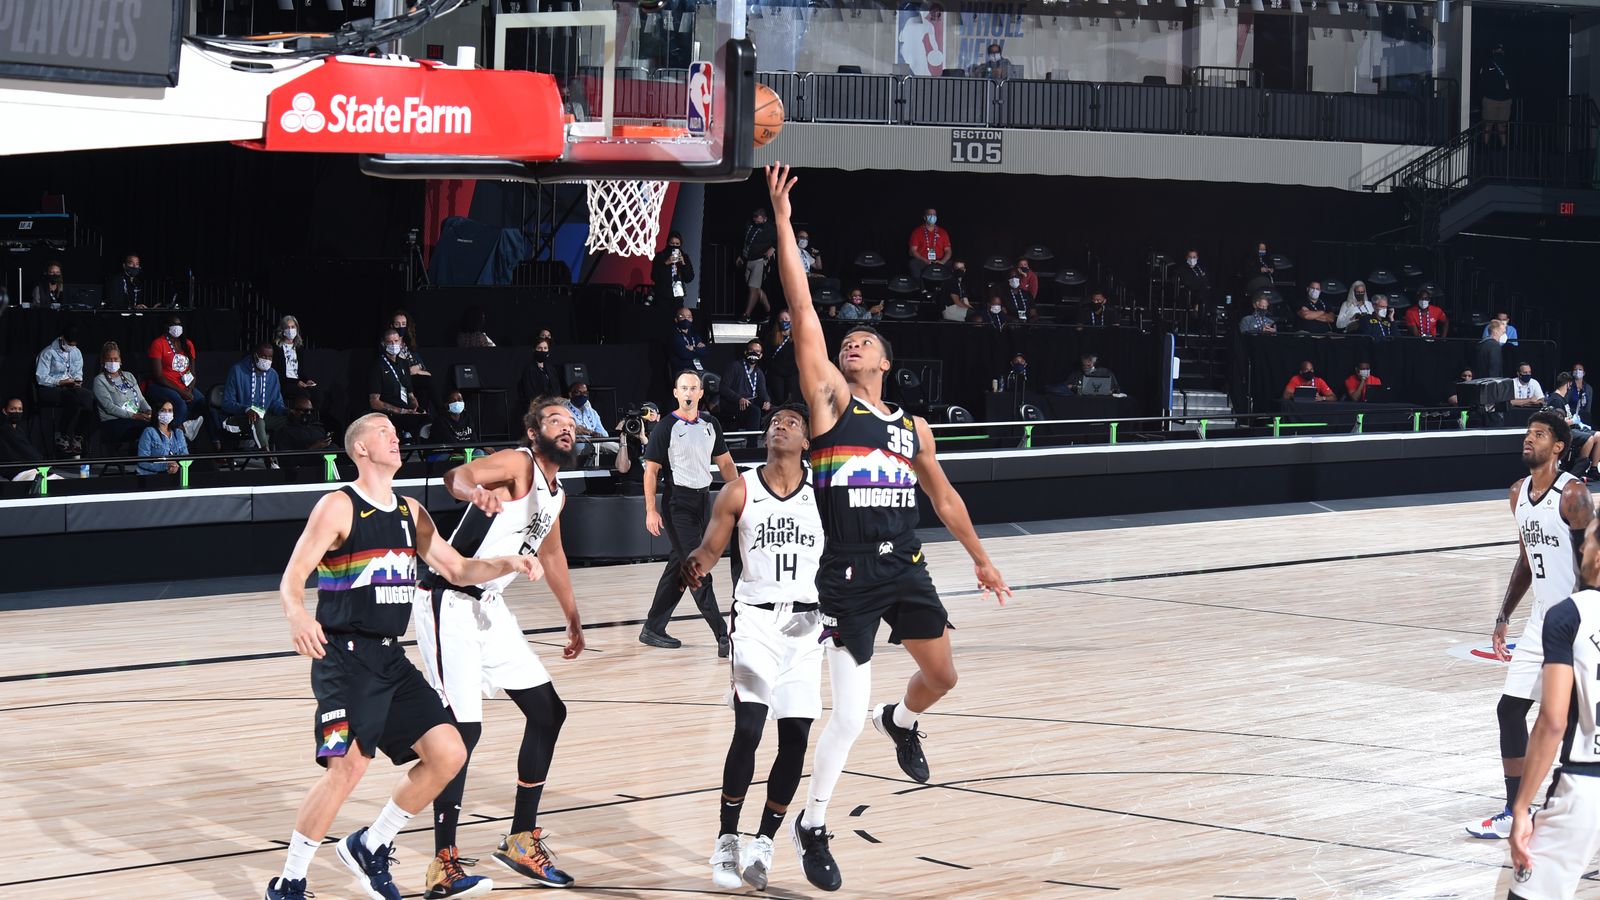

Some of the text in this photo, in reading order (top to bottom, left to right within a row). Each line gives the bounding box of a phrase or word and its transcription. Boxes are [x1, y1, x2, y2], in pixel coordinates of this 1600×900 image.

[953, 130, 1002, 140] SECTION
[952, 142, 1001, 163] 105
[887, 424, 914, 459] 35
[848, 488, 916, 508] NUGGETS
[766, 513, 795, 531] Los
[1525, 516, 1541, 533] Los
[400, 520, 413, 548] 1
[748, 522, 816, 553] Angeles
[775, 553, 798, 582] 14
[375, 586, 415, 605] NUGGE
